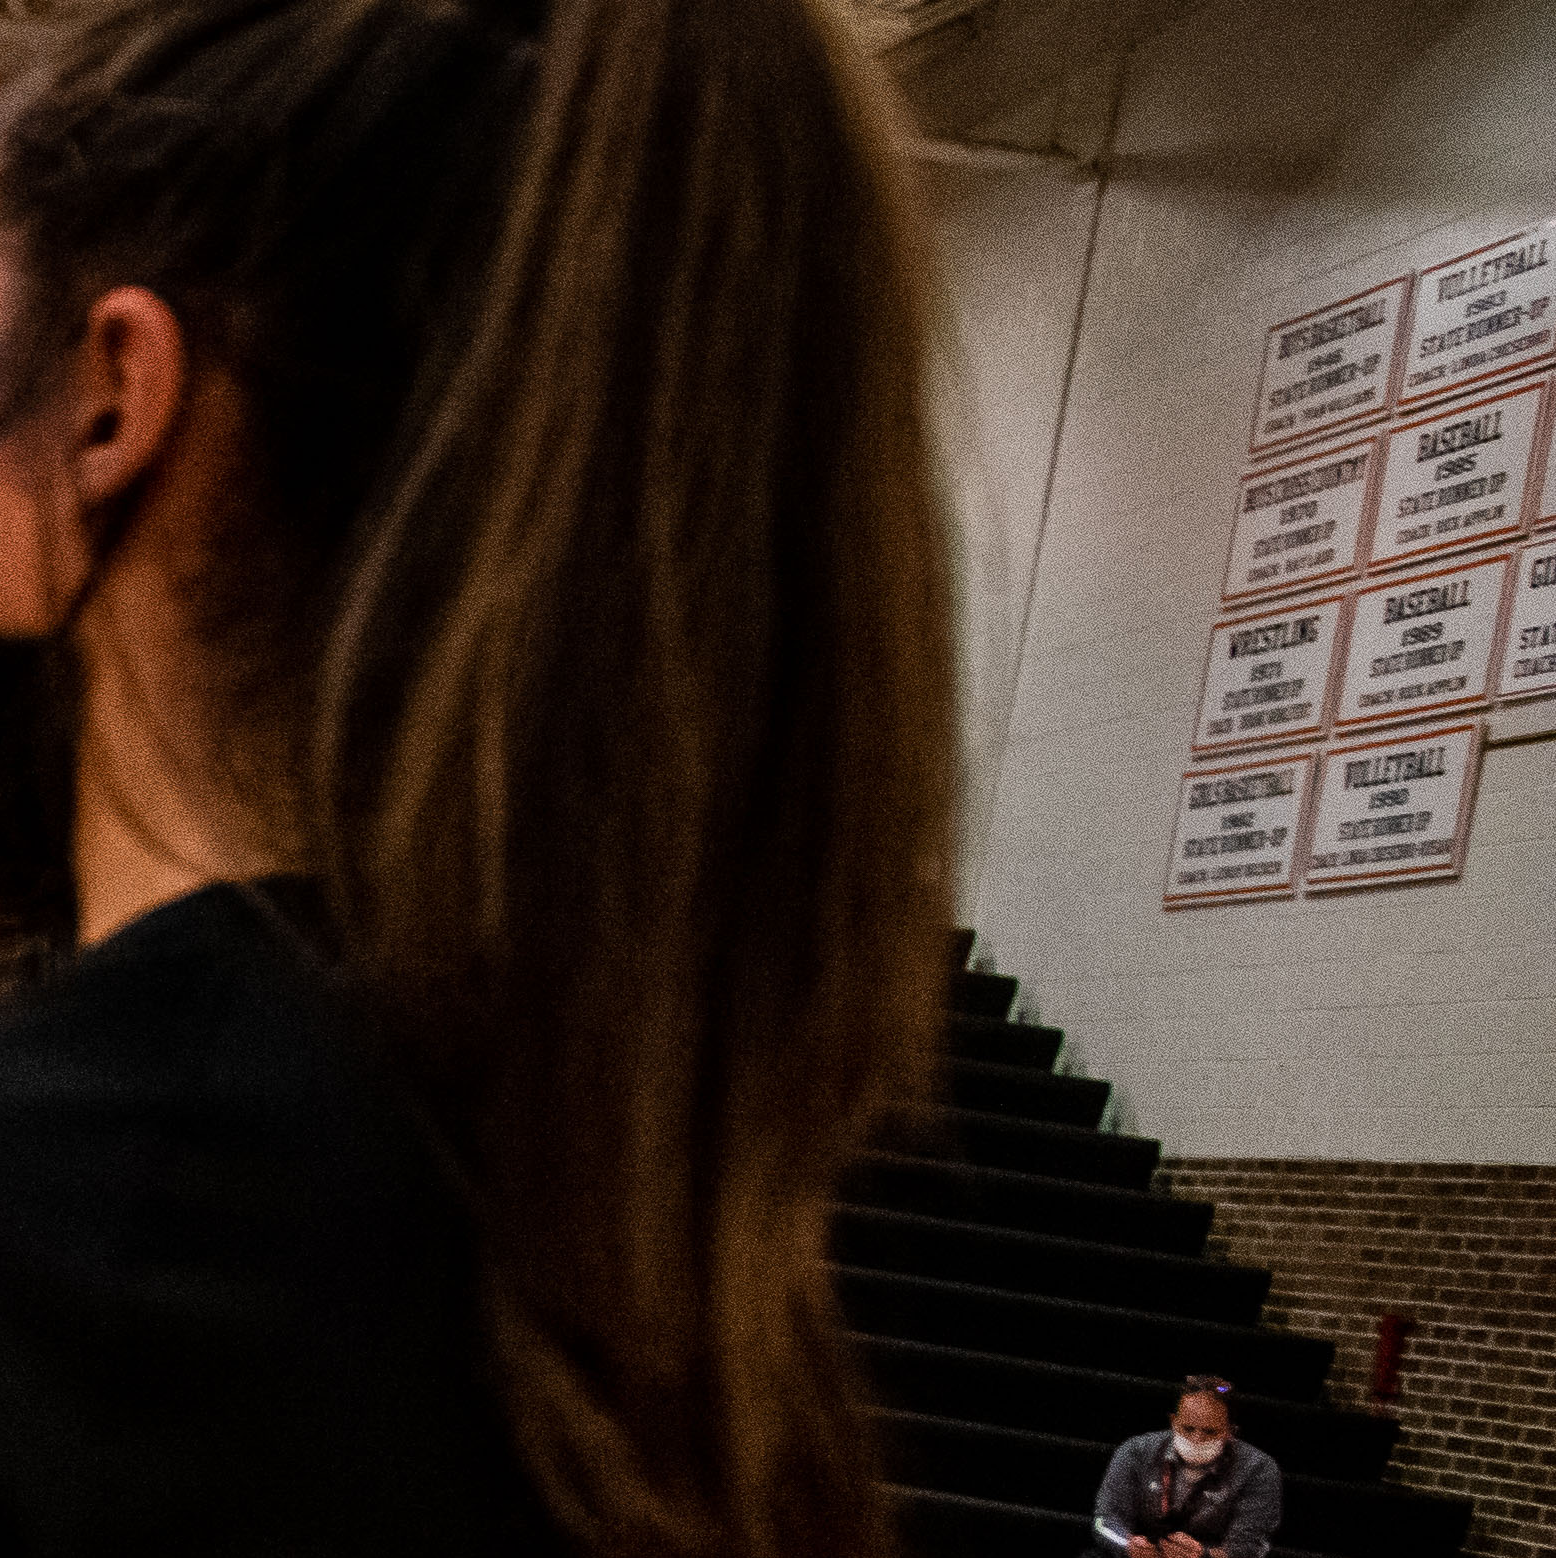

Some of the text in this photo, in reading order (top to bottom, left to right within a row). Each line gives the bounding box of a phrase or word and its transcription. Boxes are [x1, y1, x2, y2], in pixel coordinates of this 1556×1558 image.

[1437, 241, 1546, 302] VOLLEYBALL
[1417, 411, 1504, 462] BASEBALL
[1383, 580, 1472, 623] BASEBALL
[1343, 748, 1446, 789] VOLLEYBALL
